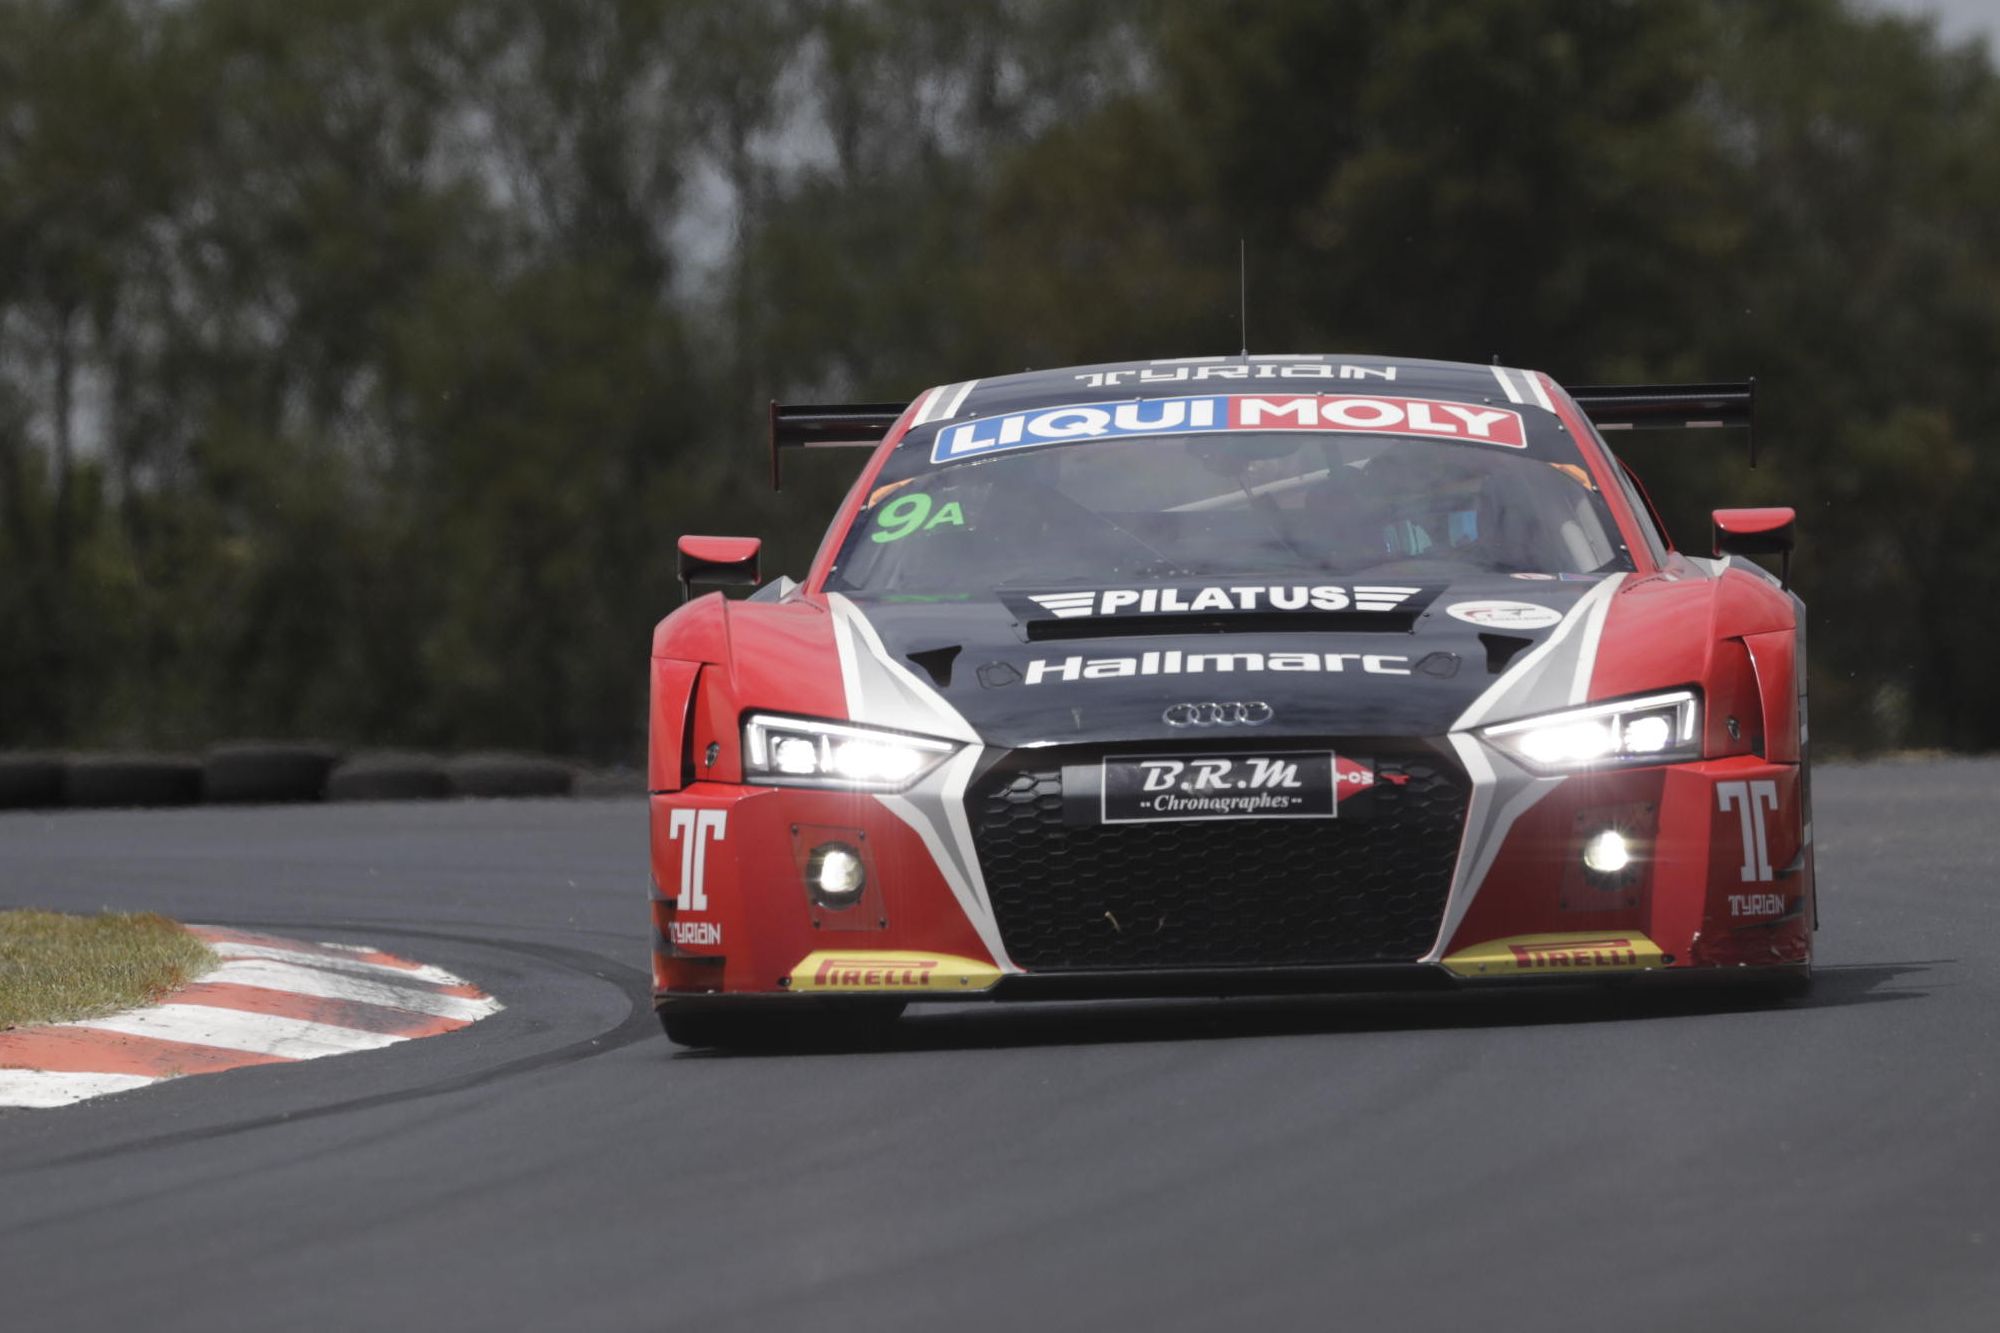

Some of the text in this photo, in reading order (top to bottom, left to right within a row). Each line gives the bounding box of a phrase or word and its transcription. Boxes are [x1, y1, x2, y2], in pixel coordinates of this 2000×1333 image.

[1075, 365, 1397, 387] TYRIAN
[950, 397, 1506, 454] LIQUI MOLY
[1101, 586, 1350, 613] PILATUS
[1025, 651, 1412, 685] Hallmarc
[1153, 793, 1289, 813] Chronographes
[1728, 894, 1785, 916] TYRIAN
[669, 922, 721, 945] TYRIAN
[1508, 938, 1636, 968] PIRELLI
[814, 958, 937, 986] PIRELLI
